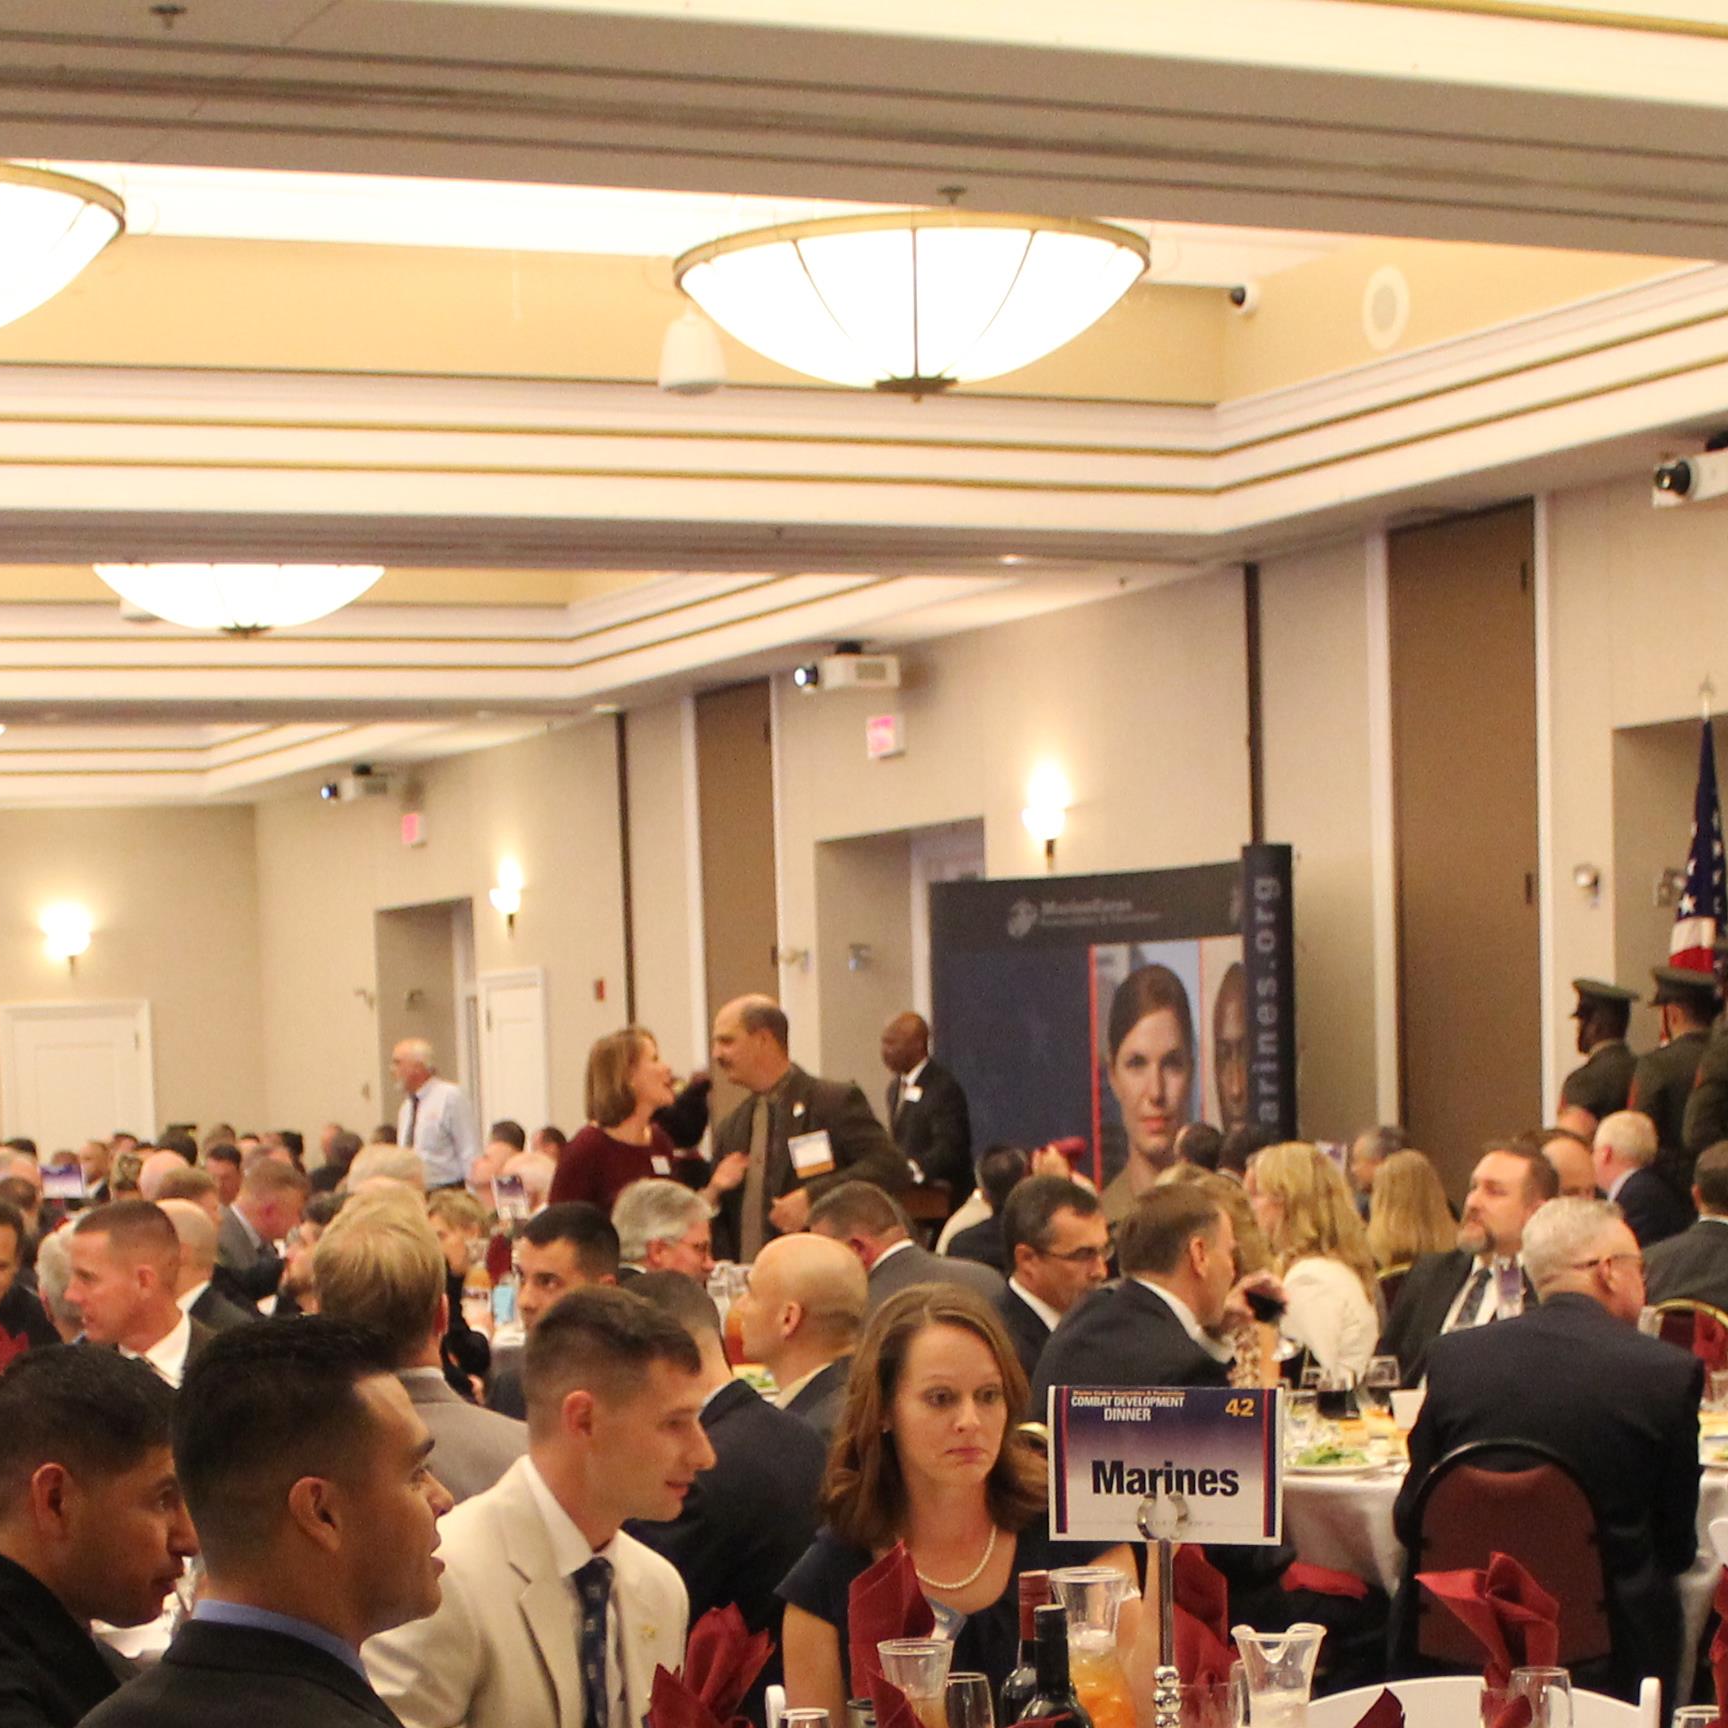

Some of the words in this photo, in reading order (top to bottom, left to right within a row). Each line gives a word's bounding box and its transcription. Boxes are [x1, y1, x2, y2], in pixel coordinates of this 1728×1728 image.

[1251, 876, 1282, 1132] arines.org
[1071, 1396, 1112, 1408] COMBAT
[1114, 1396, 1185, 1408] DEVELOPMENT
[1225, 1398, 1257, 1418] 42
[1104, 1408, 1151, 1422] DINNER
[1091, 1460, 1240, 1497] Marines
